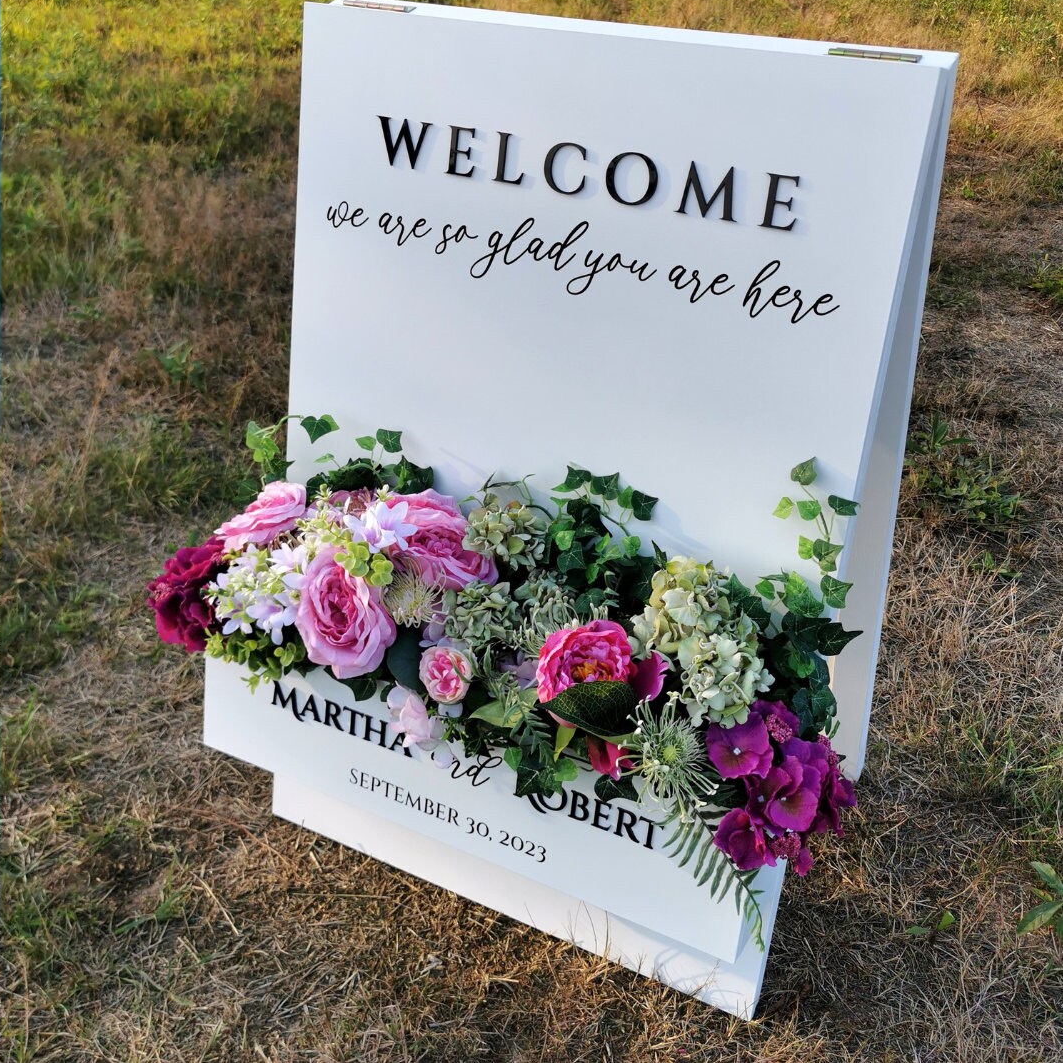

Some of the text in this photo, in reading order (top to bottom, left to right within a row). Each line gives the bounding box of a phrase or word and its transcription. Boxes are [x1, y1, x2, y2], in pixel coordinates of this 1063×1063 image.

[377, 115, 801, 232] WELCOME
[326, 200, 841, 325] we are so glad you are here
[350, 768, 547, 863] SEPTEMBER 30, 2023
